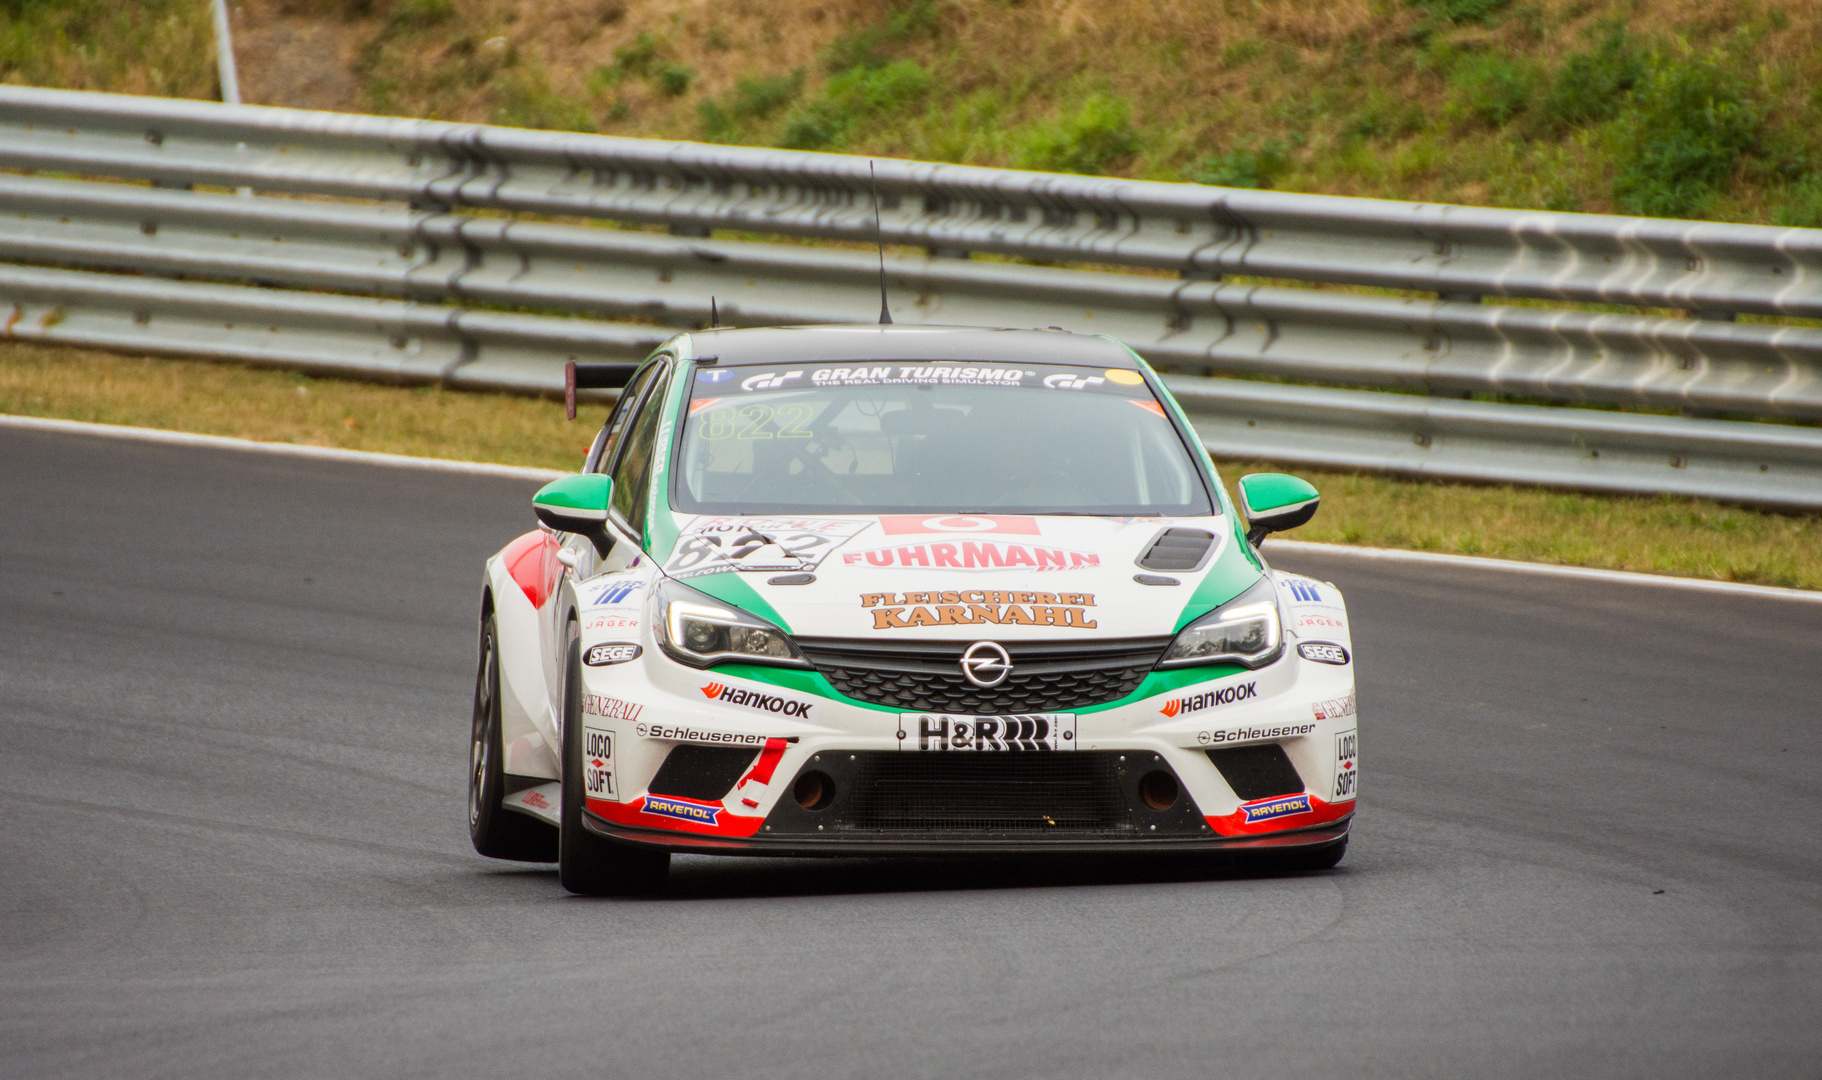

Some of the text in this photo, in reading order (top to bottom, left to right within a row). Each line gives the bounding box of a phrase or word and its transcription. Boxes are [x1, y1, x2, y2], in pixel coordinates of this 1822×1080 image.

[812, 367, 891, 381] GRAN
[945, 378, 1020, 387] SIMULATOR
[699, 402, 813, 440] 822
[844, 541, 1100, 569] FUHRMANN
[860, 589, 1097, 608] FLEISCHEREI
[872, 604, 1098, 630] KARNAHL
[589, 645, 637, 663] SEGE
[1302, 645, 1344, 661] SEGE
[584, 693, 645, 722] GENERALI
[649, 724, 767, 744] Schleusener
[1212, 723, 1316, 743] Schleusener
[586, 732, 611, 759] LOCO
[1338, 734, 1356, 761] LOCO
[586, 767, 612, 794] SOFT
[1335, 770, 1356, 797] SOFT
[649, 800, 710, 819] RAVENOL
[1250, 800, 1306, 817] RAVENOL
